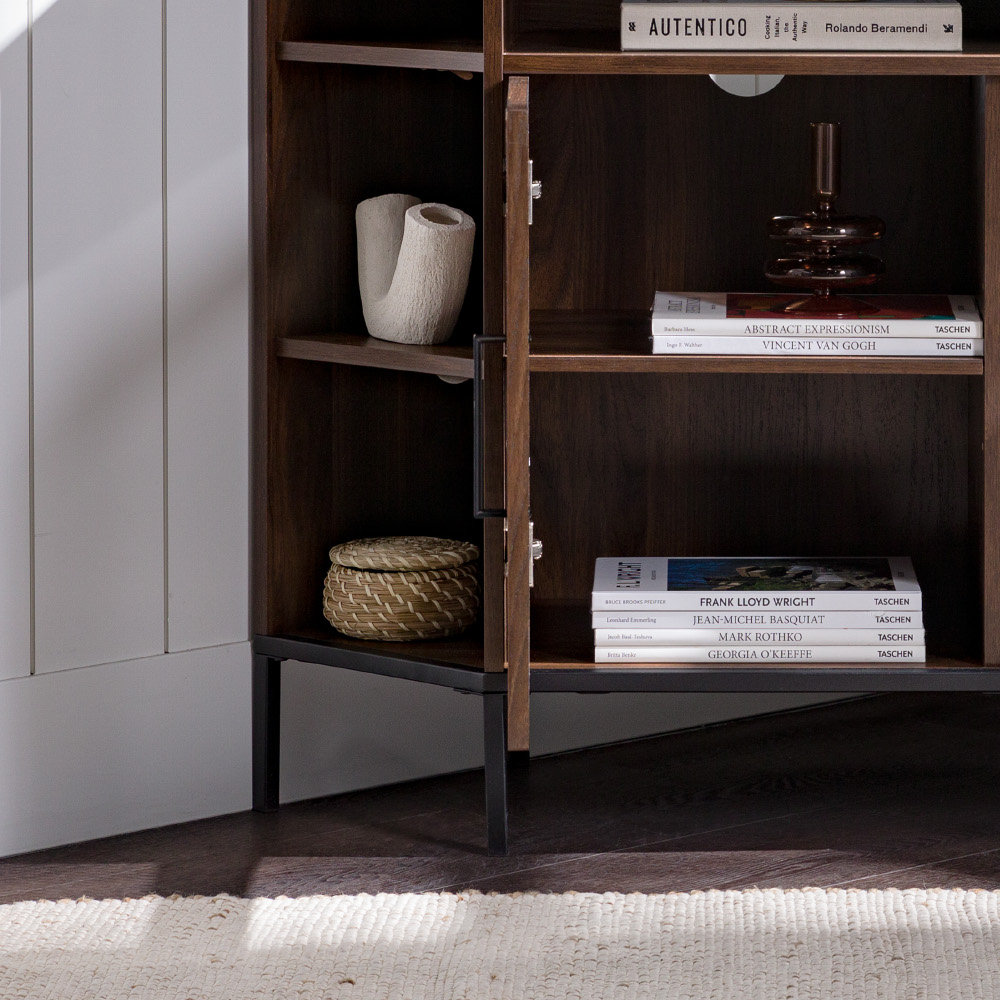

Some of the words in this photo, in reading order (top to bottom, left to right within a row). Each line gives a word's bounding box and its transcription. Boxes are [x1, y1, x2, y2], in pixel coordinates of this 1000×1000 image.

[649, 18, 747, 36] AUTENTICO
[825, 23, 868, 33] Rolando
[871, 23, 928, 33] Beramendi
[744, 325, 802, 334] ABSTRACT
[804, 325, 890, 334] EXPRESSIONISM
[763, 341, 814, 350] VINCENT
[818, 341, 840, 350] VAN
[842, 341, 876, 351] GOGH
[936, 342, 972, 350] TASCHEN
[700, 598, 734, 607] FRANK
[737, 598, 770, 607] LLOYD
[773, 598, 816, 607] WRIGHT
[874, 598, 910, 606] TASCHEN
[692, 615, 767, 626] JEAN-MICHEL
[770, 615, 825, 626] BASQUIAT
[875, 616, 911, 624] TASCHEN
[719, 632, 752, 642] MARK
[755, 632, 803, 642] ROTHKO
[878, 634, 914, 642] TASCHEN
[708, 650, 758, 659] GEORGIA
[761, 650, 813, 659] O'KEEFFE
